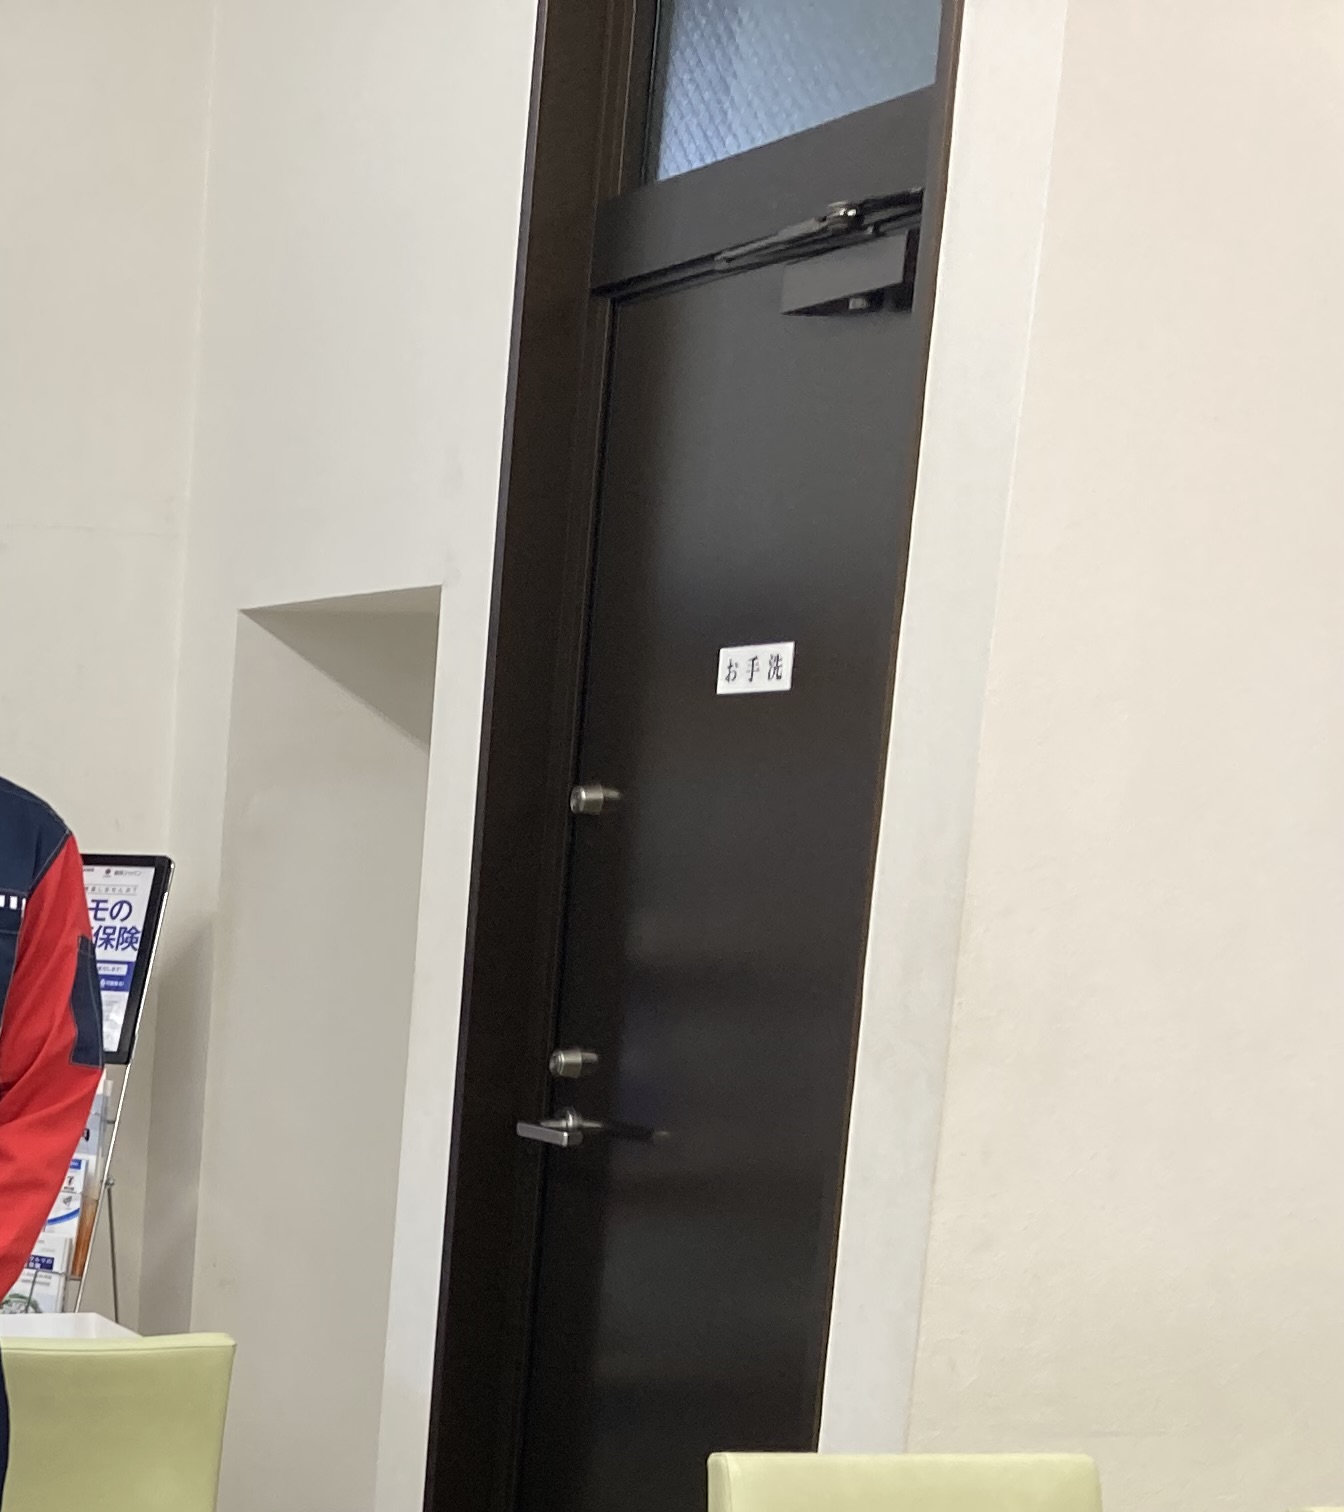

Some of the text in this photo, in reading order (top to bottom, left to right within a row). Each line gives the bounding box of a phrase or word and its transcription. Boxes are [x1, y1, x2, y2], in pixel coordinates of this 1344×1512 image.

[724, 653, 783, 683] お手洗
[92, 924, 142, 952] 保険
